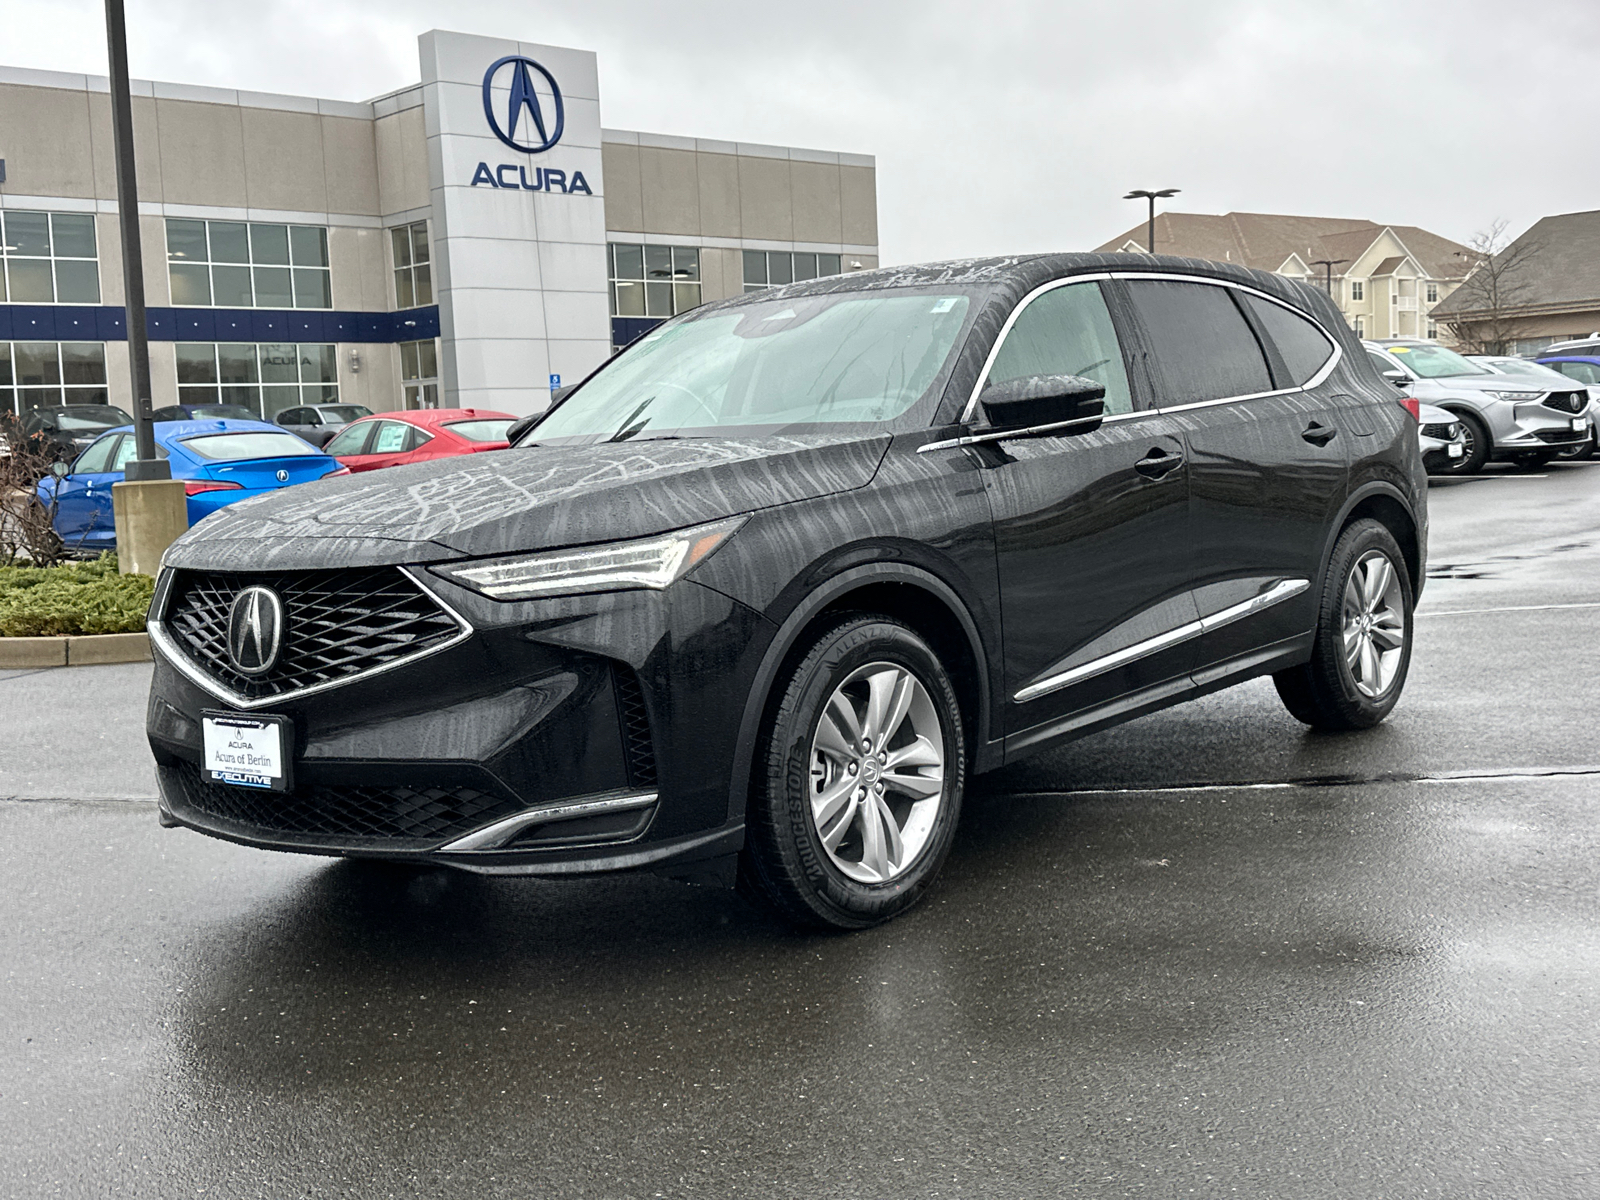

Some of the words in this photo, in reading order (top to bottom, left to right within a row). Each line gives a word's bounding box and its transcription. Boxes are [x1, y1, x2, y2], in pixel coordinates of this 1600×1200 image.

[470, 161, 593, 195] ACURA
[228, 741, 254, 750] ACURA
[215, 750, 236, 764] Acura
[237, 754, 246, 765] of
[247, 754, 272, 767] Berlin
[211, 770, 272, 785] EXECUTIVE
[788, 746, 824, 881] BRIDGESTONE
